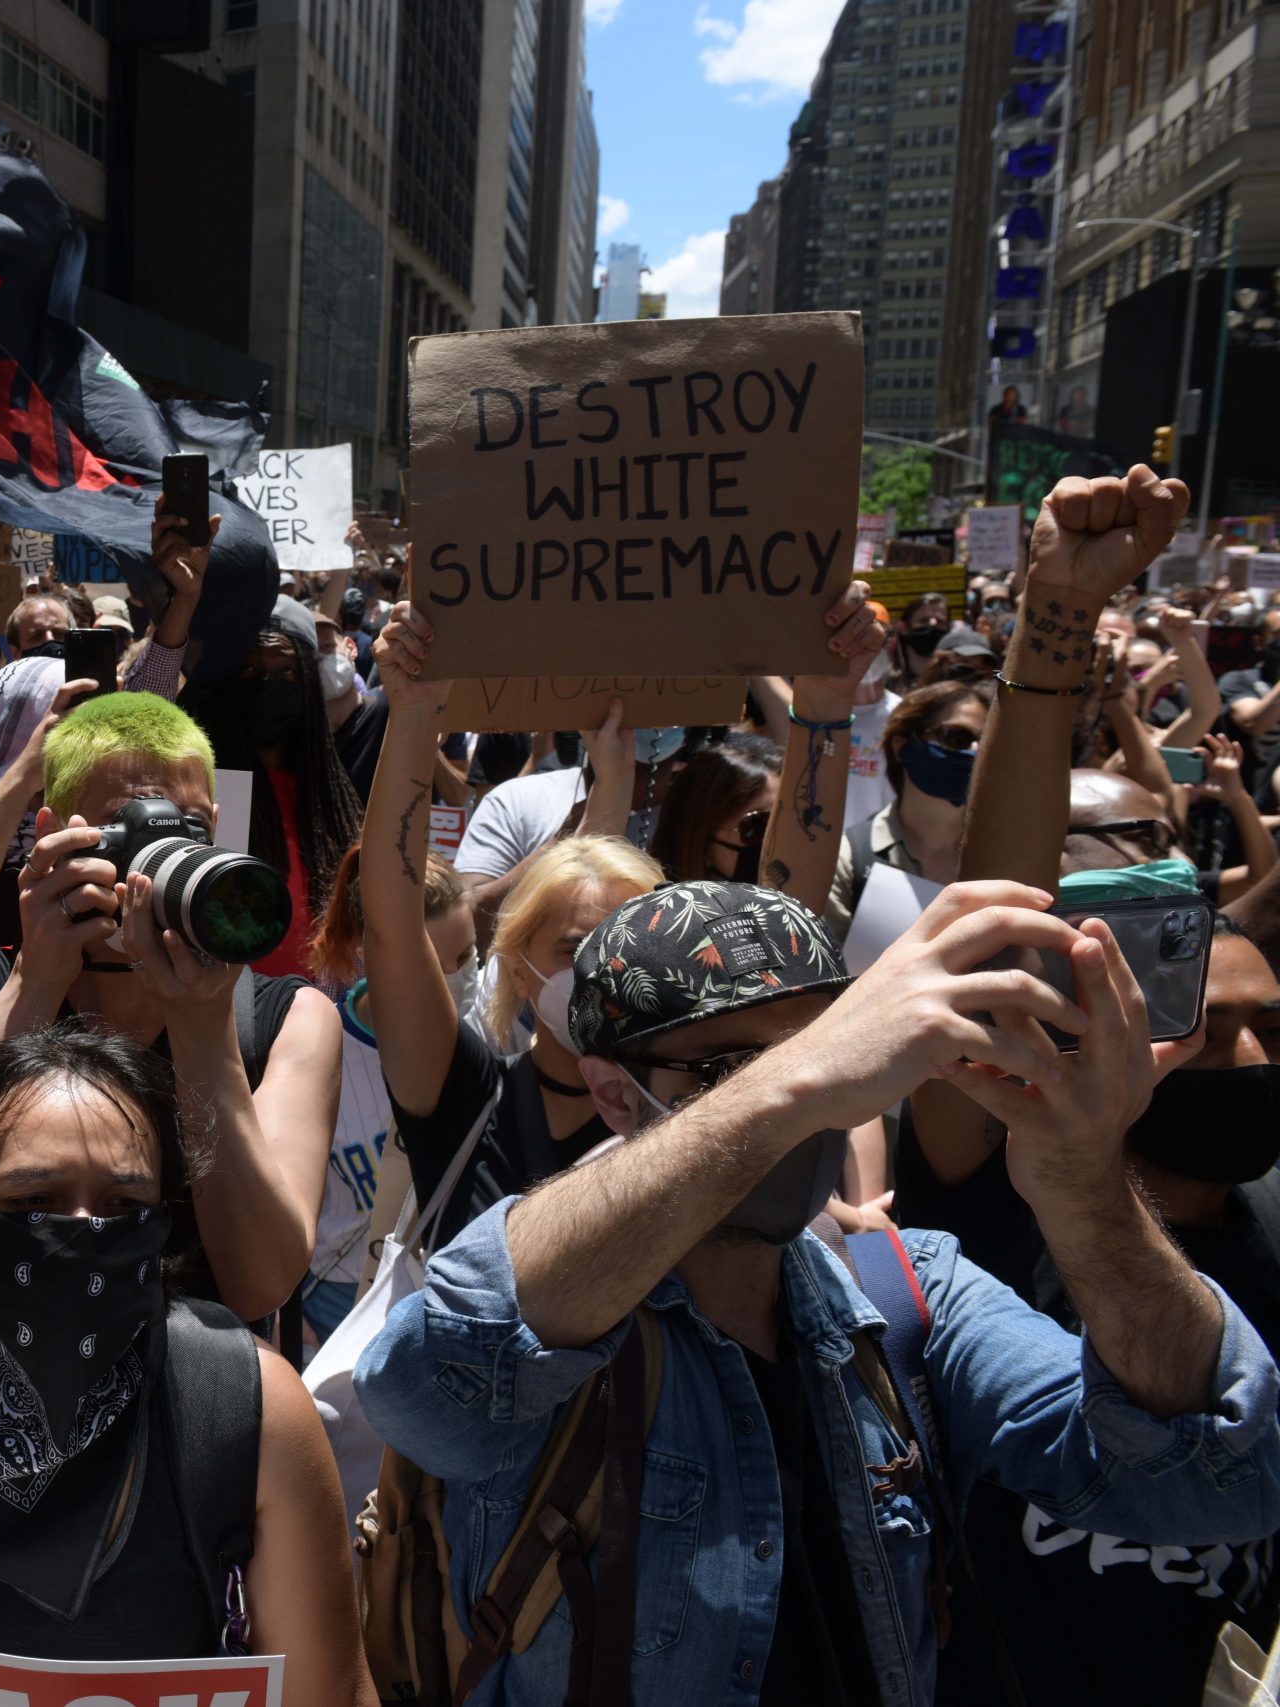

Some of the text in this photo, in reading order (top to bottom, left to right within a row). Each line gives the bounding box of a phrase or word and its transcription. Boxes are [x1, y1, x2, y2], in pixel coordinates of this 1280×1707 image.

[470, 362, 817, 452] DESTROY
[524, 451, 750, 522] WHITE
[428, 530, 843, 607] SUPREMACY
[148, 818, 181, 826] Canon
[712, 918, 756, 934] ALTERNATE
[722, 927, 755, 940] FUTURE
